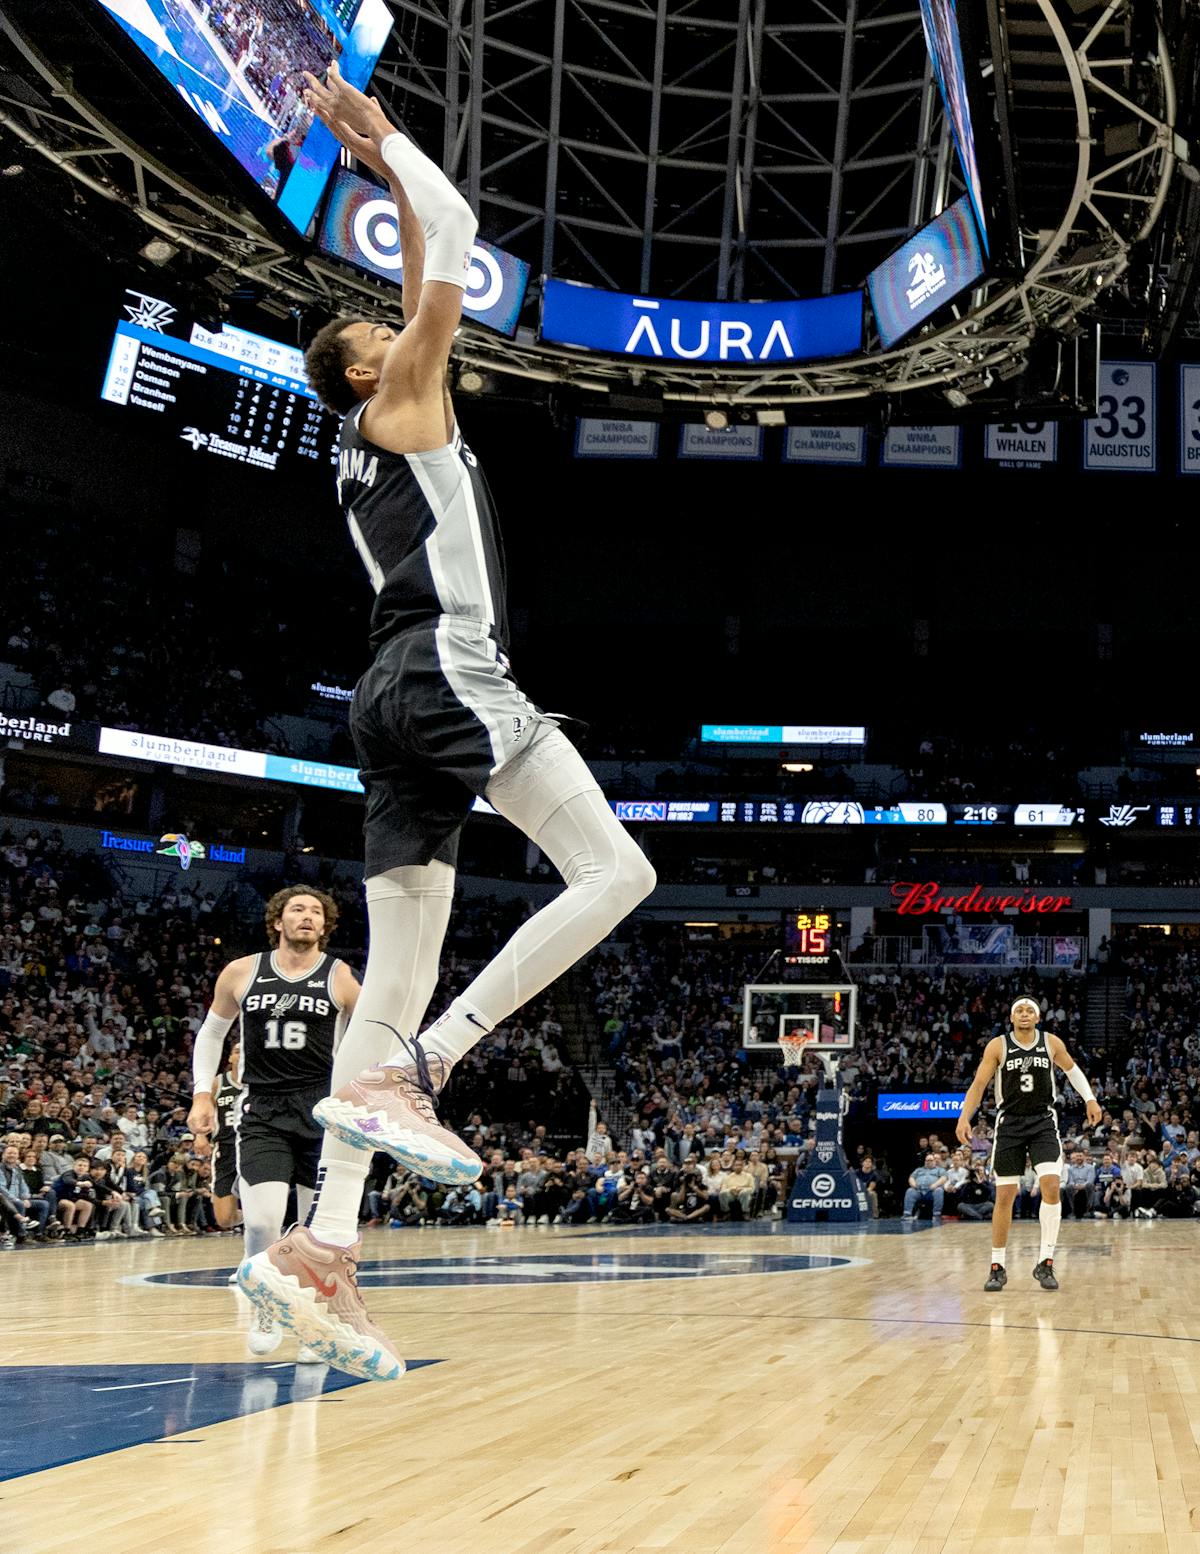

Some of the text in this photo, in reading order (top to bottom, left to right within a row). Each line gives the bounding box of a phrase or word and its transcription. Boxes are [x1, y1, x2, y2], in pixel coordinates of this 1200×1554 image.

[138, 358, 180, 378] Johnson
[141, 344, 207, 374] Wembanyama
[135, 370, 170, 388] Osman
[132, 382, 176, 403] Branham
[239, 378, 296, 403] 11 7 4 3
[130, 393, 165, 412] Vassell
[237, 390, 293, 415] 3 4 2 2
[235, 401, 291, 426] 7 2 0 0
[1094, 395, 1147, 440] 33
[230, 413, 241, 423] 10
[248, 418, 254, 427] 1
[264, 424, 272, 432] 0
[281, 429, 288, 438] 1
[602, 422, 633, 433] WNBA
[810, 429, 841, 439] WNBA
[227, 425, 239, 435] 12
[244, 429, 252, 438] 5
[261, 435, 269, 444] 2
[277, 440, 285, 449] 0
[585, 434, 648, 445] CHAMPIONS
[690, 435, 753, 446] CHAMPIONS
[794, 439, 857, 451] CHAMPIONS
[907, 433, 937, 443] WNBA
[209, 433, 280, 465] Treasure Island
[890, 443, 952, 455] CHAMPIONS
[995, 439, 1047, 455] WHALEN
[1089, 443, 1151, 459] AUGUSTUS
[1140, 733, 1194, 741] slumberland
[131, 736, 238, 763] slumberland
[146, 751, 221, 769] FURNITURE
[290, 763, 359, 782] slumberl
[617, 803, 666, 820] KFAN
[875, 809, 935, 821] 4 2 80
[963, 806, 998, 821] 2:16
[1028, 810, 1045, 823] 61
[1077, 814, 1084, 823] 4
[101, 830, 246, 864] Treasure Island
[890, 881, 1072, 915] Budweiser
[797, 914, 829, 930] 2:15
[801, 928, 825, 952] 15
[796, 956, 829, 964] TISSOT
[264, 1020, 308, 1050] 16
[1020, 1074, 1034, 1092] 3
[930, 1101, 965, 1111] ULTRA
[792, 1199, 853, 1209] CFMOTO
